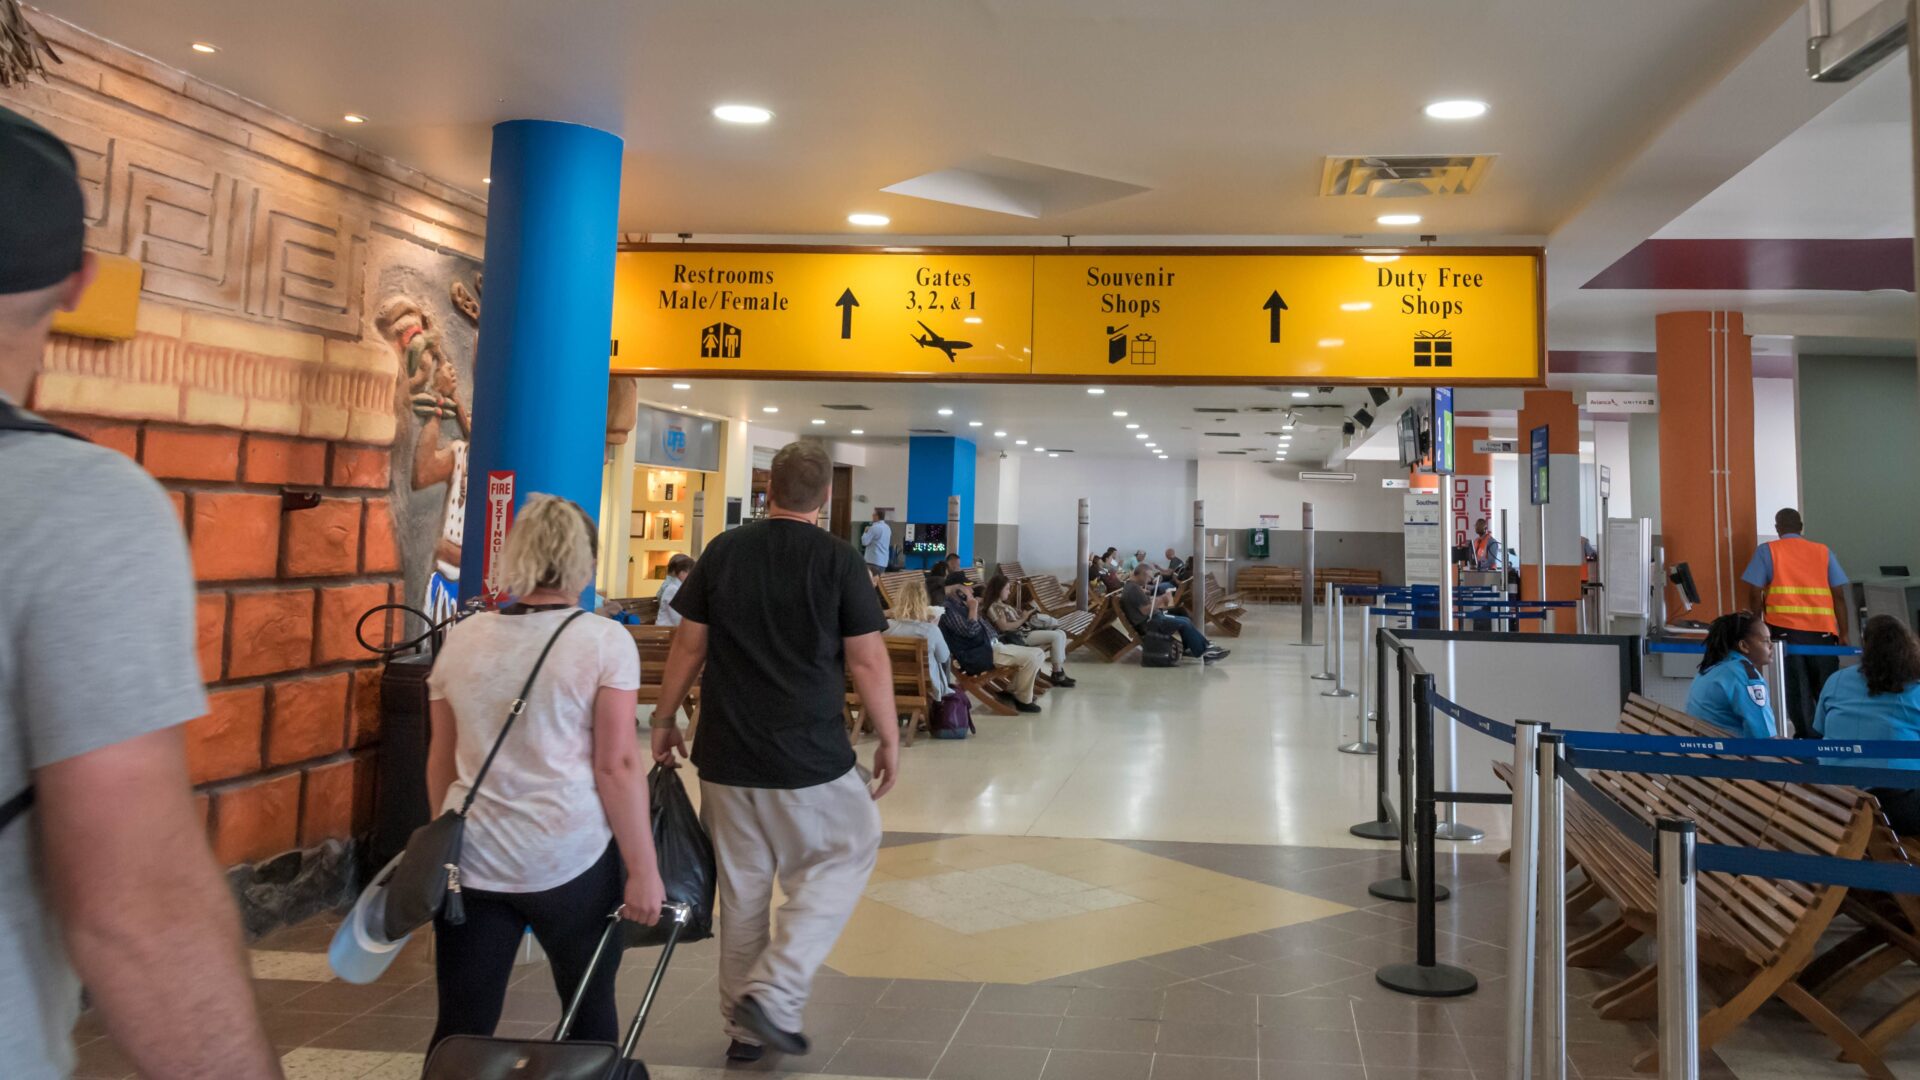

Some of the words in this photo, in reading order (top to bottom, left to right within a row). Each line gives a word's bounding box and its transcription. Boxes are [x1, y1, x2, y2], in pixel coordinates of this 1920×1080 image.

[673, 264, 775, 286] Restrooms
[916, 267, 971, 288] Gates
[1086, 266, 1176, 288] Souvenir
[1377, 267, 1428, 292] Duty
[1437, 267, 1484, 288] Free
[658, 290, 790, 312] Male/Female
[906, 290, 923, 312] 3,
[928, 291, 945, 312] 2,
[950, 296, 961, 311] &
[968, 290, 976, 310] 1
[1101, 293, 1162, 318] Shops
[1401, 294, 1464, 319] Shops
[491, 483, 511, 495] FIRE
[490, 499, 504, 592] EXTINGUIR
[1680, 742, 1714, 750] UNITED
[1817, 745, 1852, 753] UNITED
